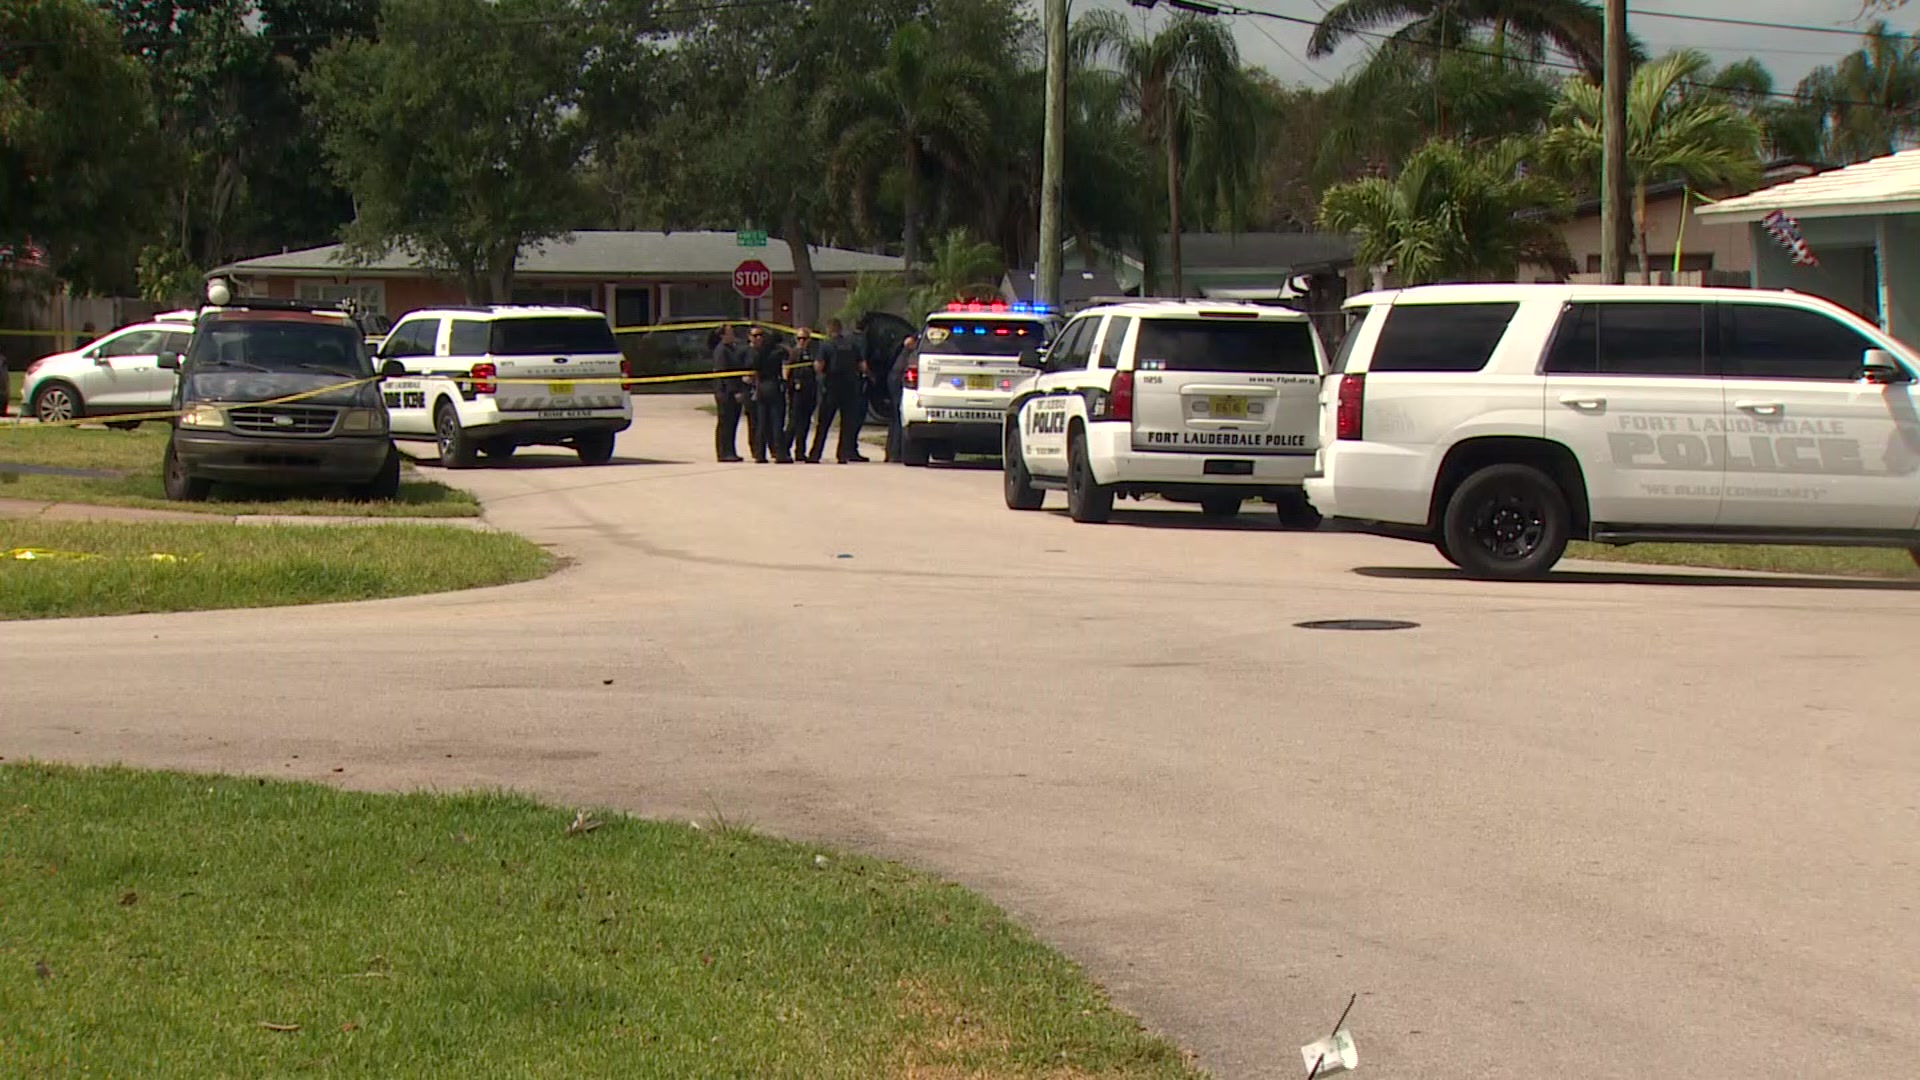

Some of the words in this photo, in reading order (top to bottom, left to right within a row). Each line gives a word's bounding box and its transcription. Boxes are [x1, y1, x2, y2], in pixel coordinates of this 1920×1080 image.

[735, 271, 769, 287] STOP
[926, 410, 945, 418] FORT
[949, 410, 1002, 420] LAUDERDALE
[1032, 411, 1065, 434] POLICE
[1619, 415, 1678, 432] FORT
[1688, 416, 1846, 435] LAUDERDALE
[1148, 432, 1179, 444] FORT
[1184, 432, 1261, 446] LAUDERDALE
[1265, 435, 1306, 446] POLICE
[1607, 432, 1863, 474] POLICE
[1674, 485, 1719, 497] BUILD
